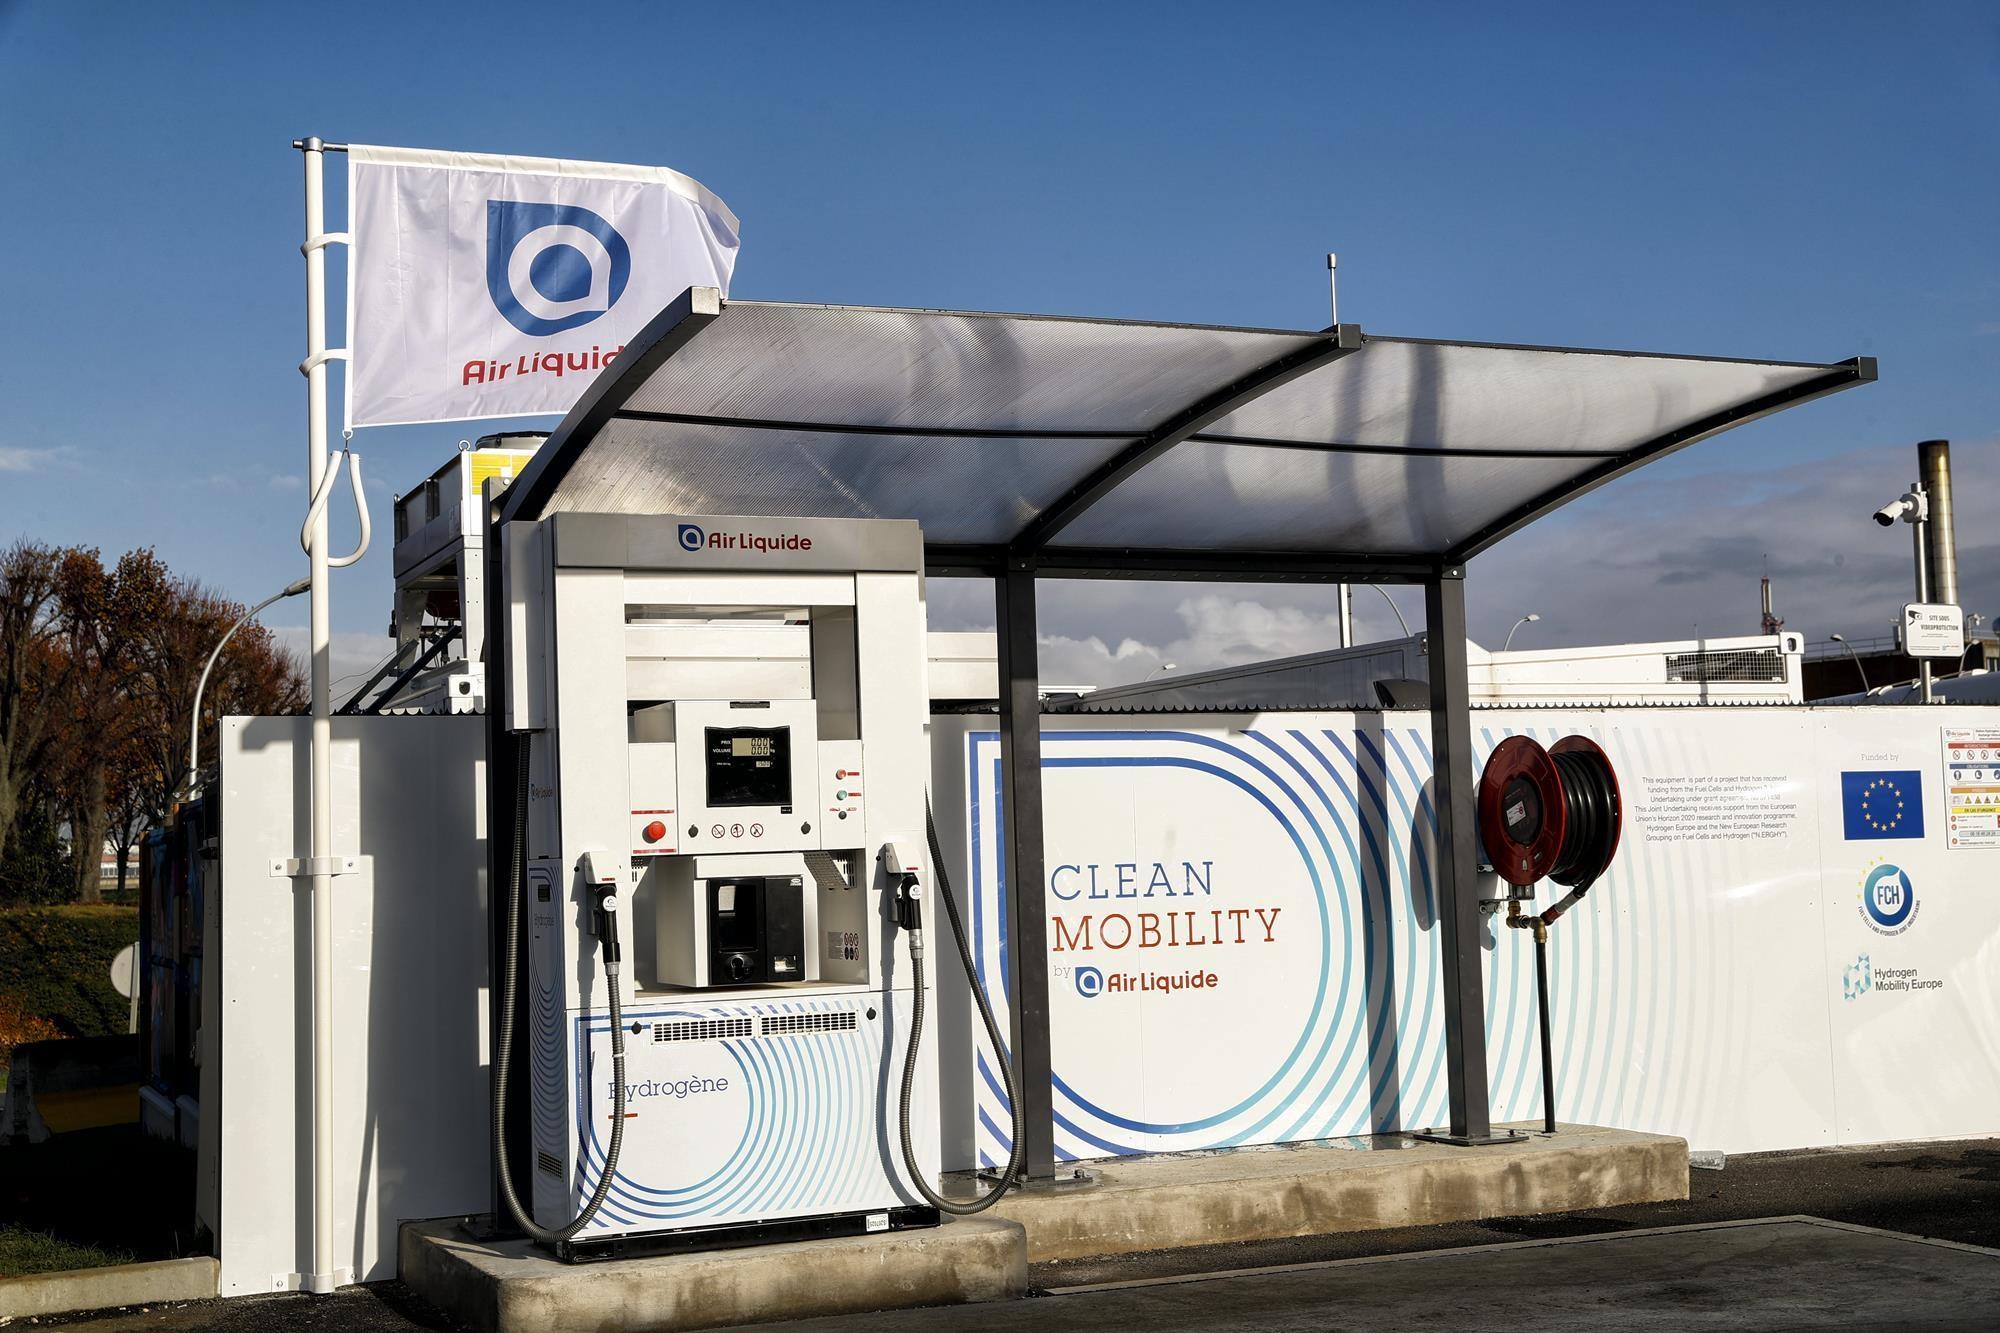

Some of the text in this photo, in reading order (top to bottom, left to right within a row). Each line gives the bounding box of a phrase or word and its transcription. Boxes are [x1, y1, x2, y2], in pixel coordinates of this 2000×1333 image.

[463, 345, 625, 386] Air Liquid
[708, 532, 812, 553] Air Liquide
[1861, 753, 1899, 762] Funded by
[1655, 776, 1685, 784] equipment
[1719, 776, 1738, 784] project
[1648, 786, 1669, 794] funding
[1650, 796, 1685, 804] Undertaking
[1663, 805, 1698, 813] Undertaking
[1723, 804, 1744, 812] support
[1733, 822, 1760, 830] European
[1645, 834, 1673, 842] Grouping
[1722, 832, 1750, 841] Hydrogen
[1050, 861, 1214, 901] CLEAN
[1877, 885, 1900, 905] FCH
[1052, 908, 1282, 952] MOBILITY
[1053, 965, 1219, 994] by Air Liquide
[1874, 968, 1918, 981] Hydrogen
[1875, 978, 1943, 992] Mobility Europe
